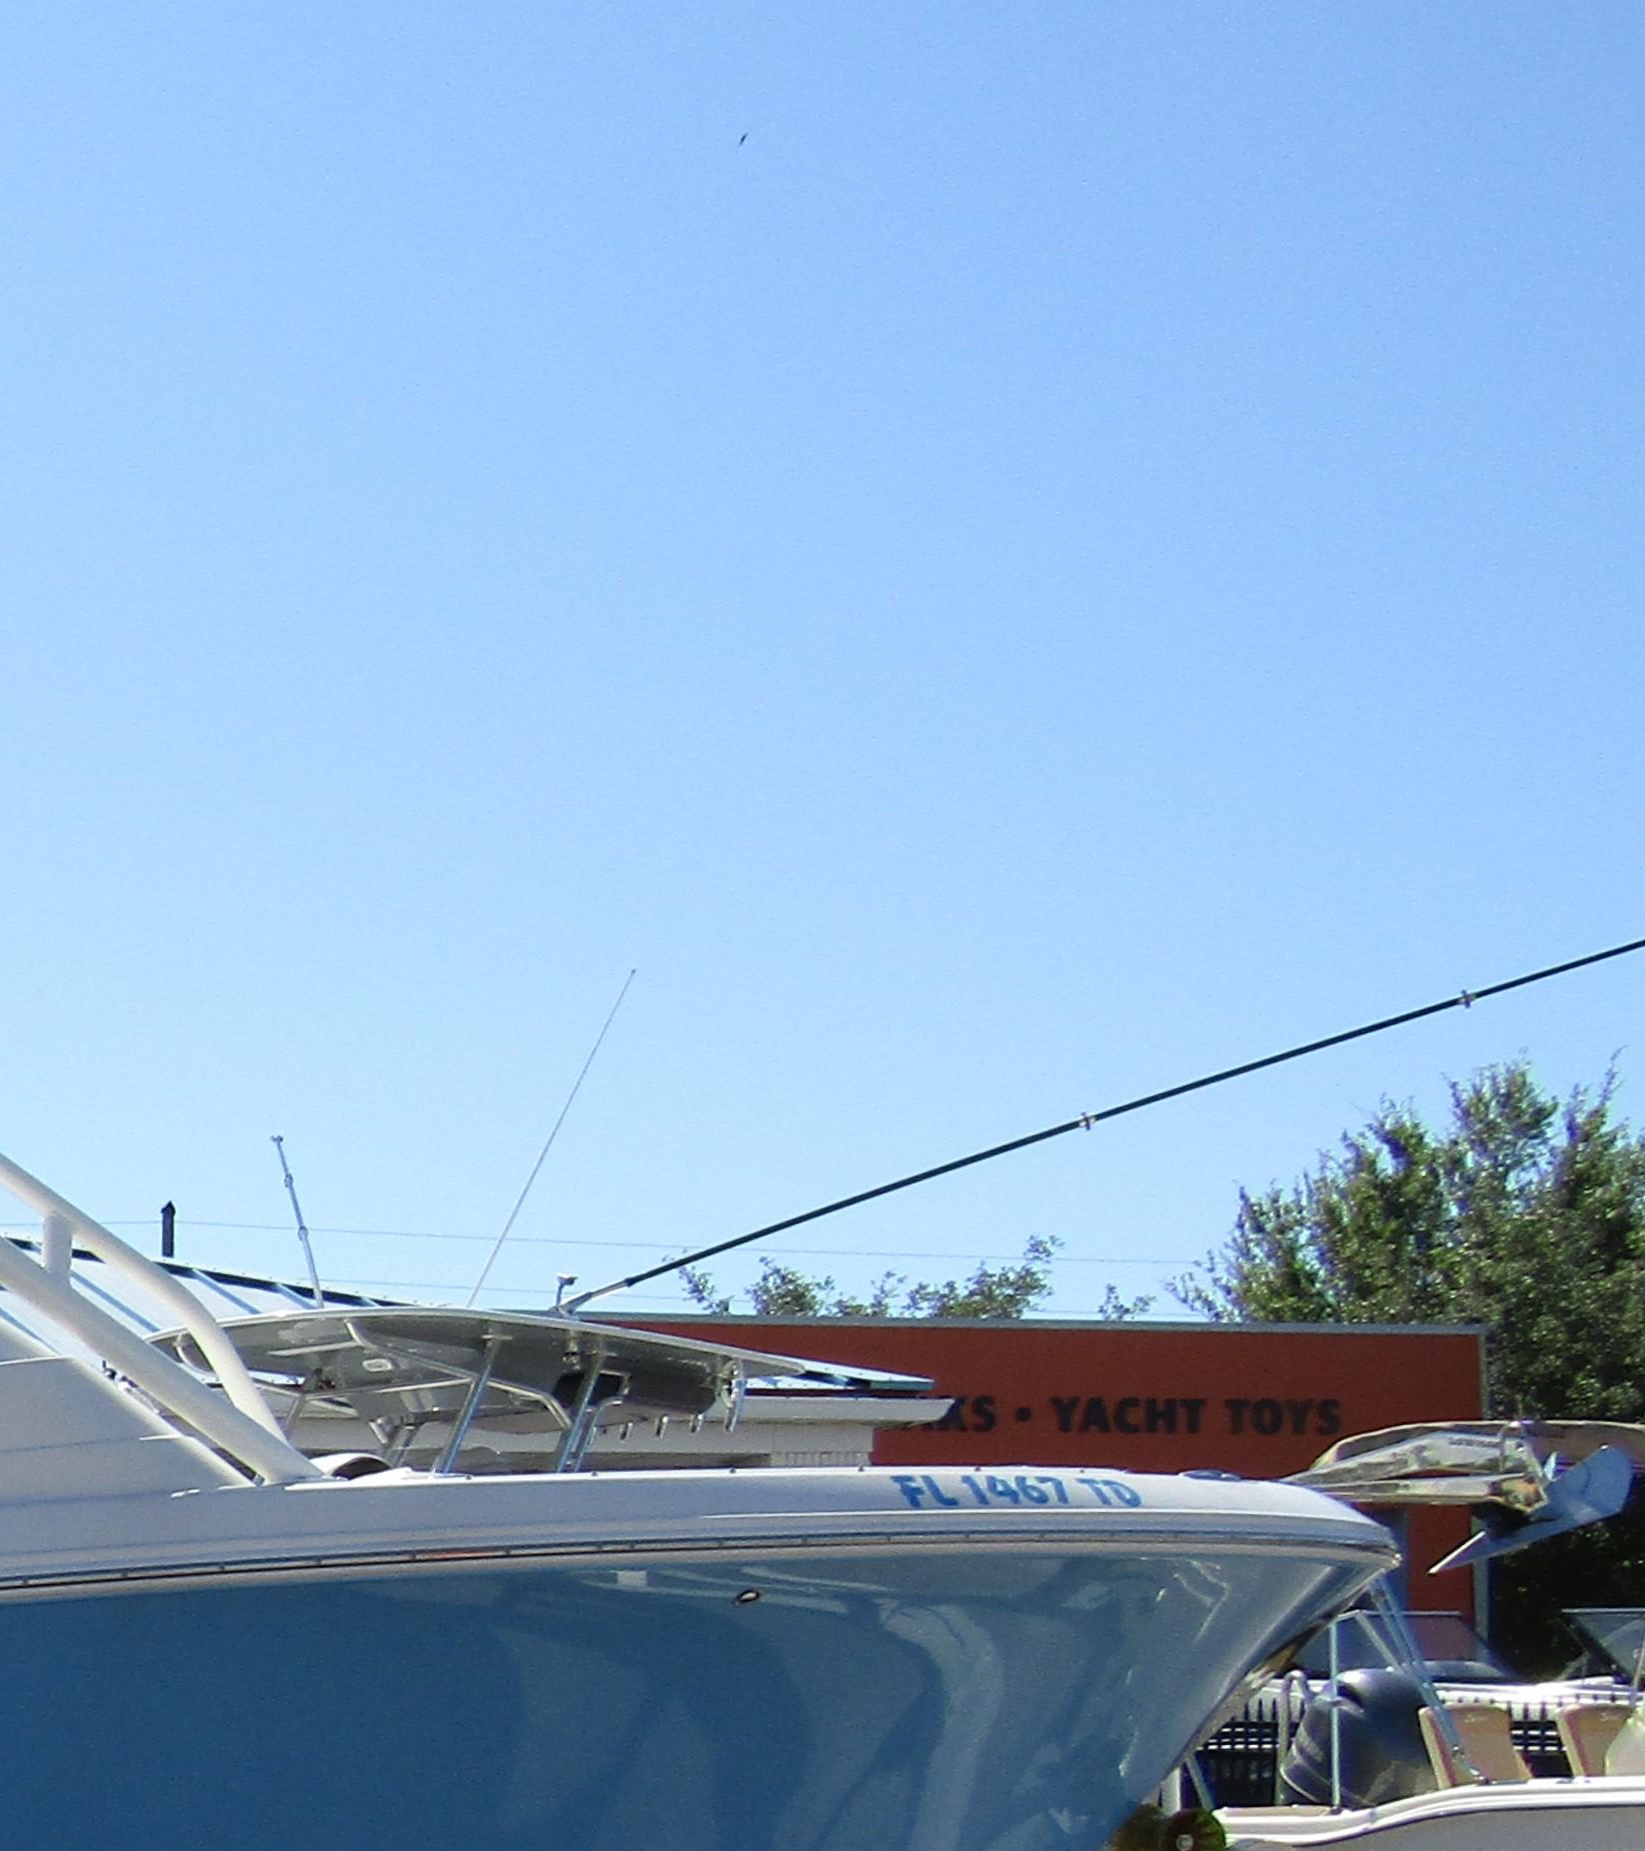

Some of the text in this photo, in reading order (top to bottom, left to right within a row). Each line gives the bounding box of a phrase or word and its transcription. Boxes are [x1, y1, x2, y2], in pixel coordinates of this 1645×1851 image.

[1048, 1395, 1208, 1435] YACHT
[1224, 1396, 1342, 1436] TOYS
[890, 1475, 960, 1508] FL
[962, 1475, 1072, 1506] 1467
